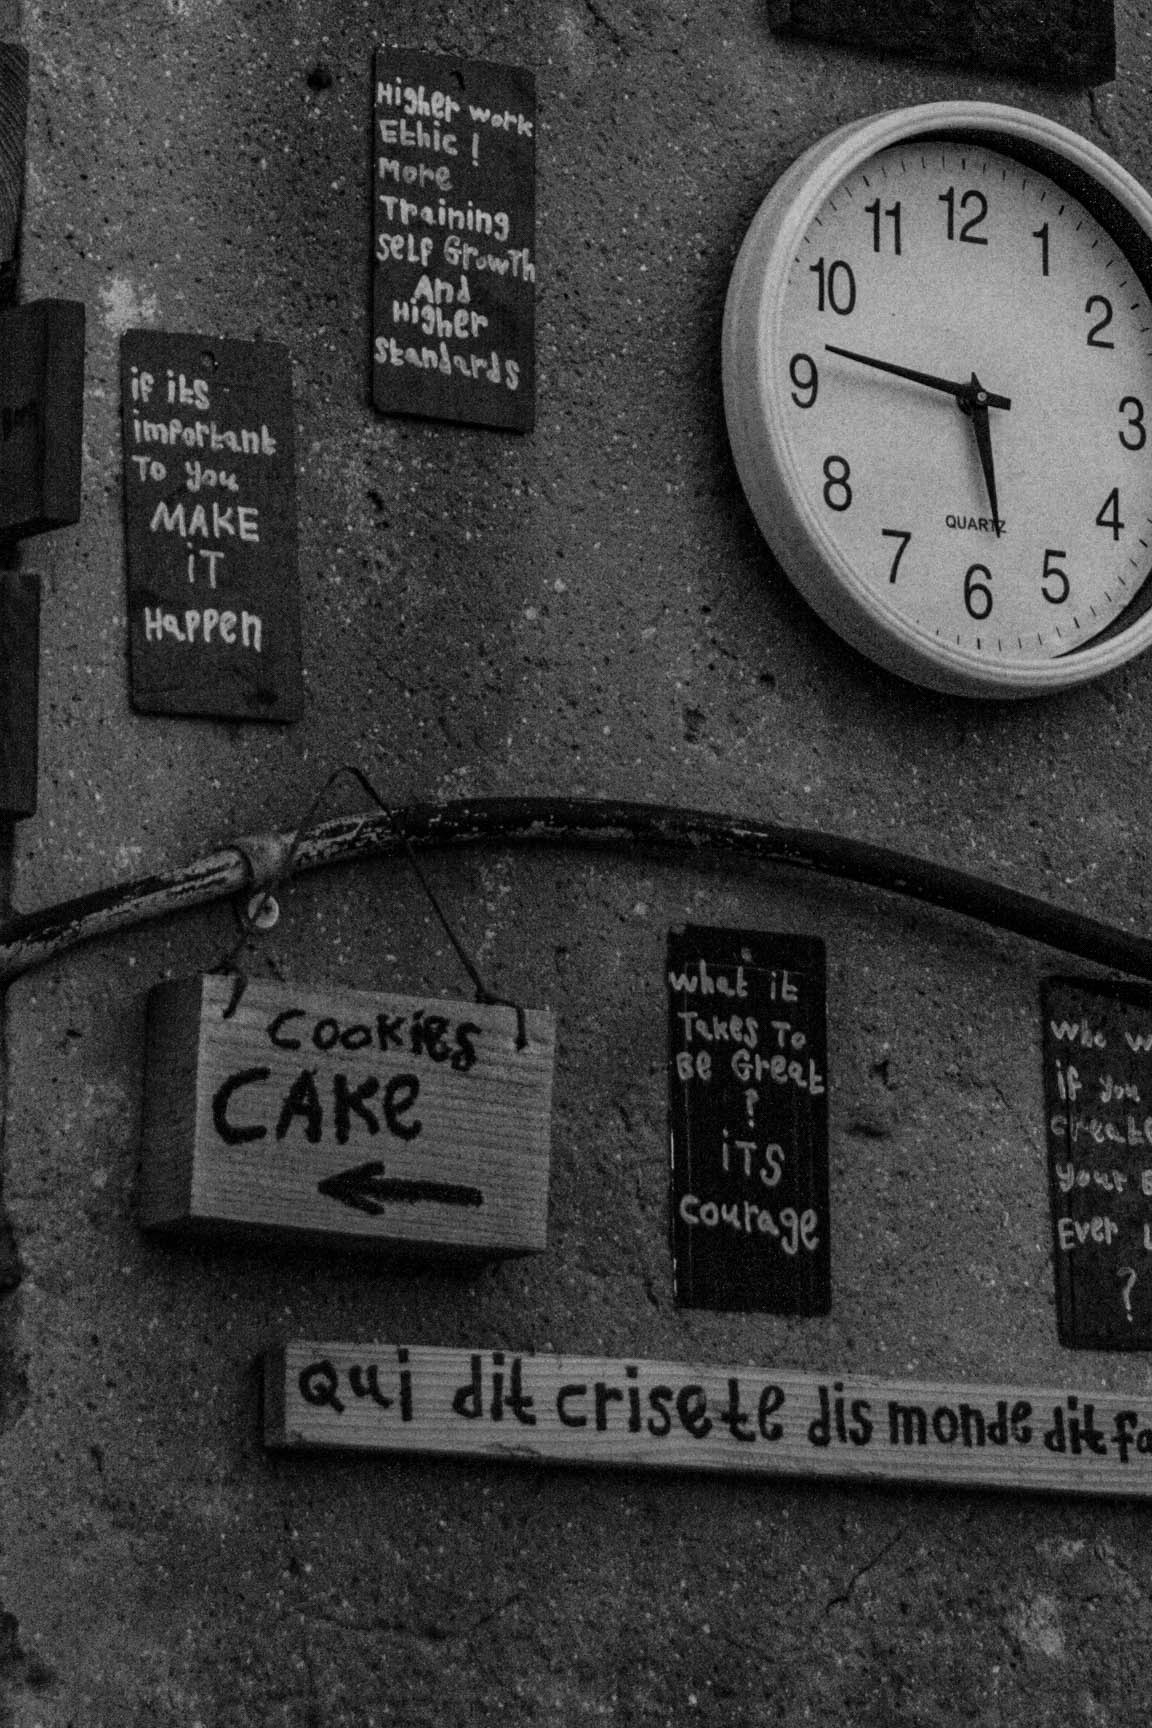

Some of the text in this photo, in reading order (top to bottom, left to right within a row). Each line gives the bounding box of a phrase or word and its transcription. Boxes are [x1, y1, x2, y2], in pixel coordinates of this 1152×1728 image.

[377, 76, 460, 123] Higher
[379, 118, 457, 156] Ethic
[379, 156, 454, 192] More
[379, 195, 510, 242] Training
[865, 197, 902, 256] 11
[938, 186, 989, 245] 12
[1032, 222, 1050, 277] 1
[809, 257, 856, 316] 10
[392, 296, 489, 339] Higher
[1085, 294, 1115, 350] 2
[788, 352, 819, 409] 9
[1117, 396, 1148, 451] 3
[822, 455, 854, 512] 8
[149, 501, 260, 543] MAKE
[944, 513, 1008, 535] QUARTZ
[1095, 486, 1125, 542] 4
[881, 527, 912, 584] 7
[1040, 548, 1071, 605] 5
[963, 563, 994, 621] 6
[452, 1351, 537, 1426] dit
[807, 1381, 873, 1447] dis
[888, 1400, 1033, 1448] monde
[1043, 1395, 1107, 1455] dit
